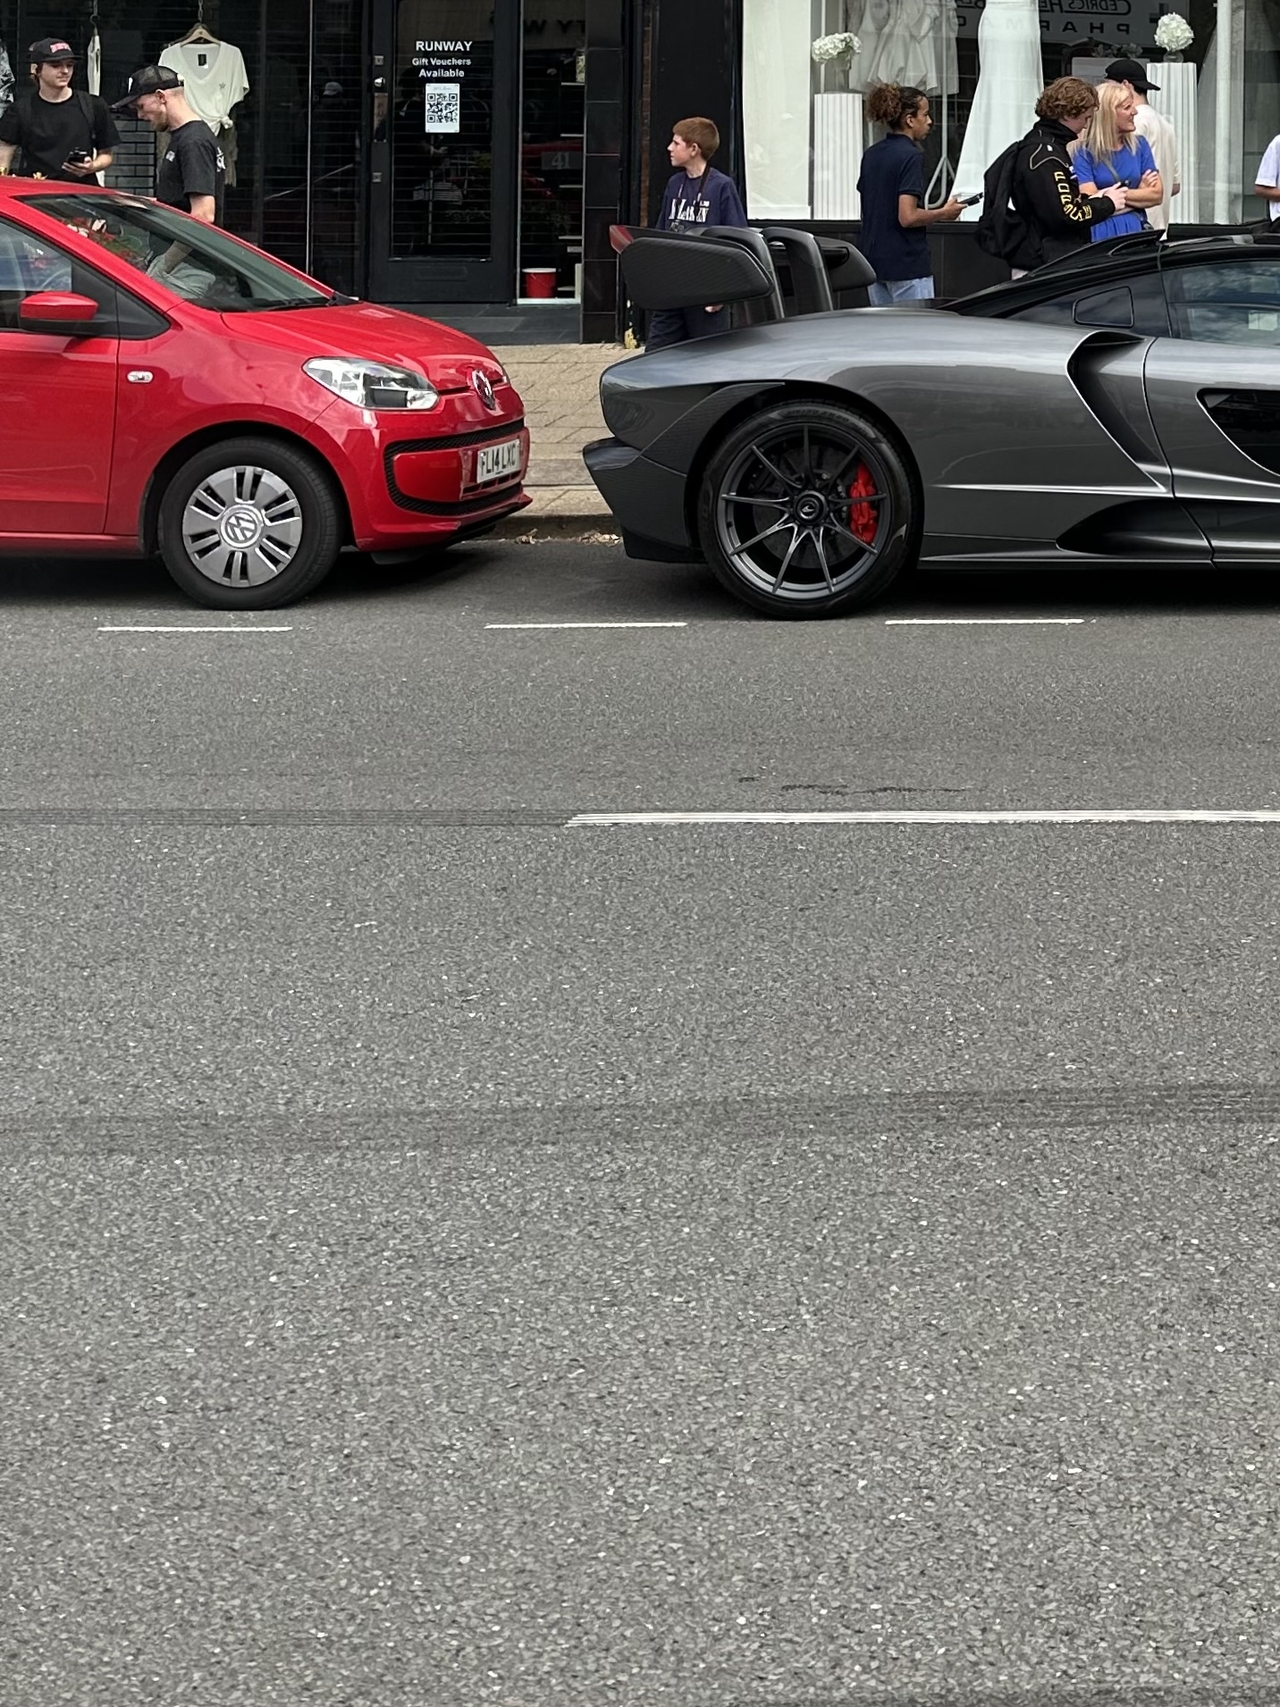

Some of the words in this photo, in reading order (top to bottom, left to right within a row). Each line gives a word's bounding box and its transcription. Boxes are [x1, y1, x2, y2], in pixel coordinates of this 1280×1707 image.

[415, 40, 473, 51] RUNWAY
[412, 57, 429, 66] Gift
[430, 57, 471, 65] Vouchers
[418, 68, 465, 78] Available
